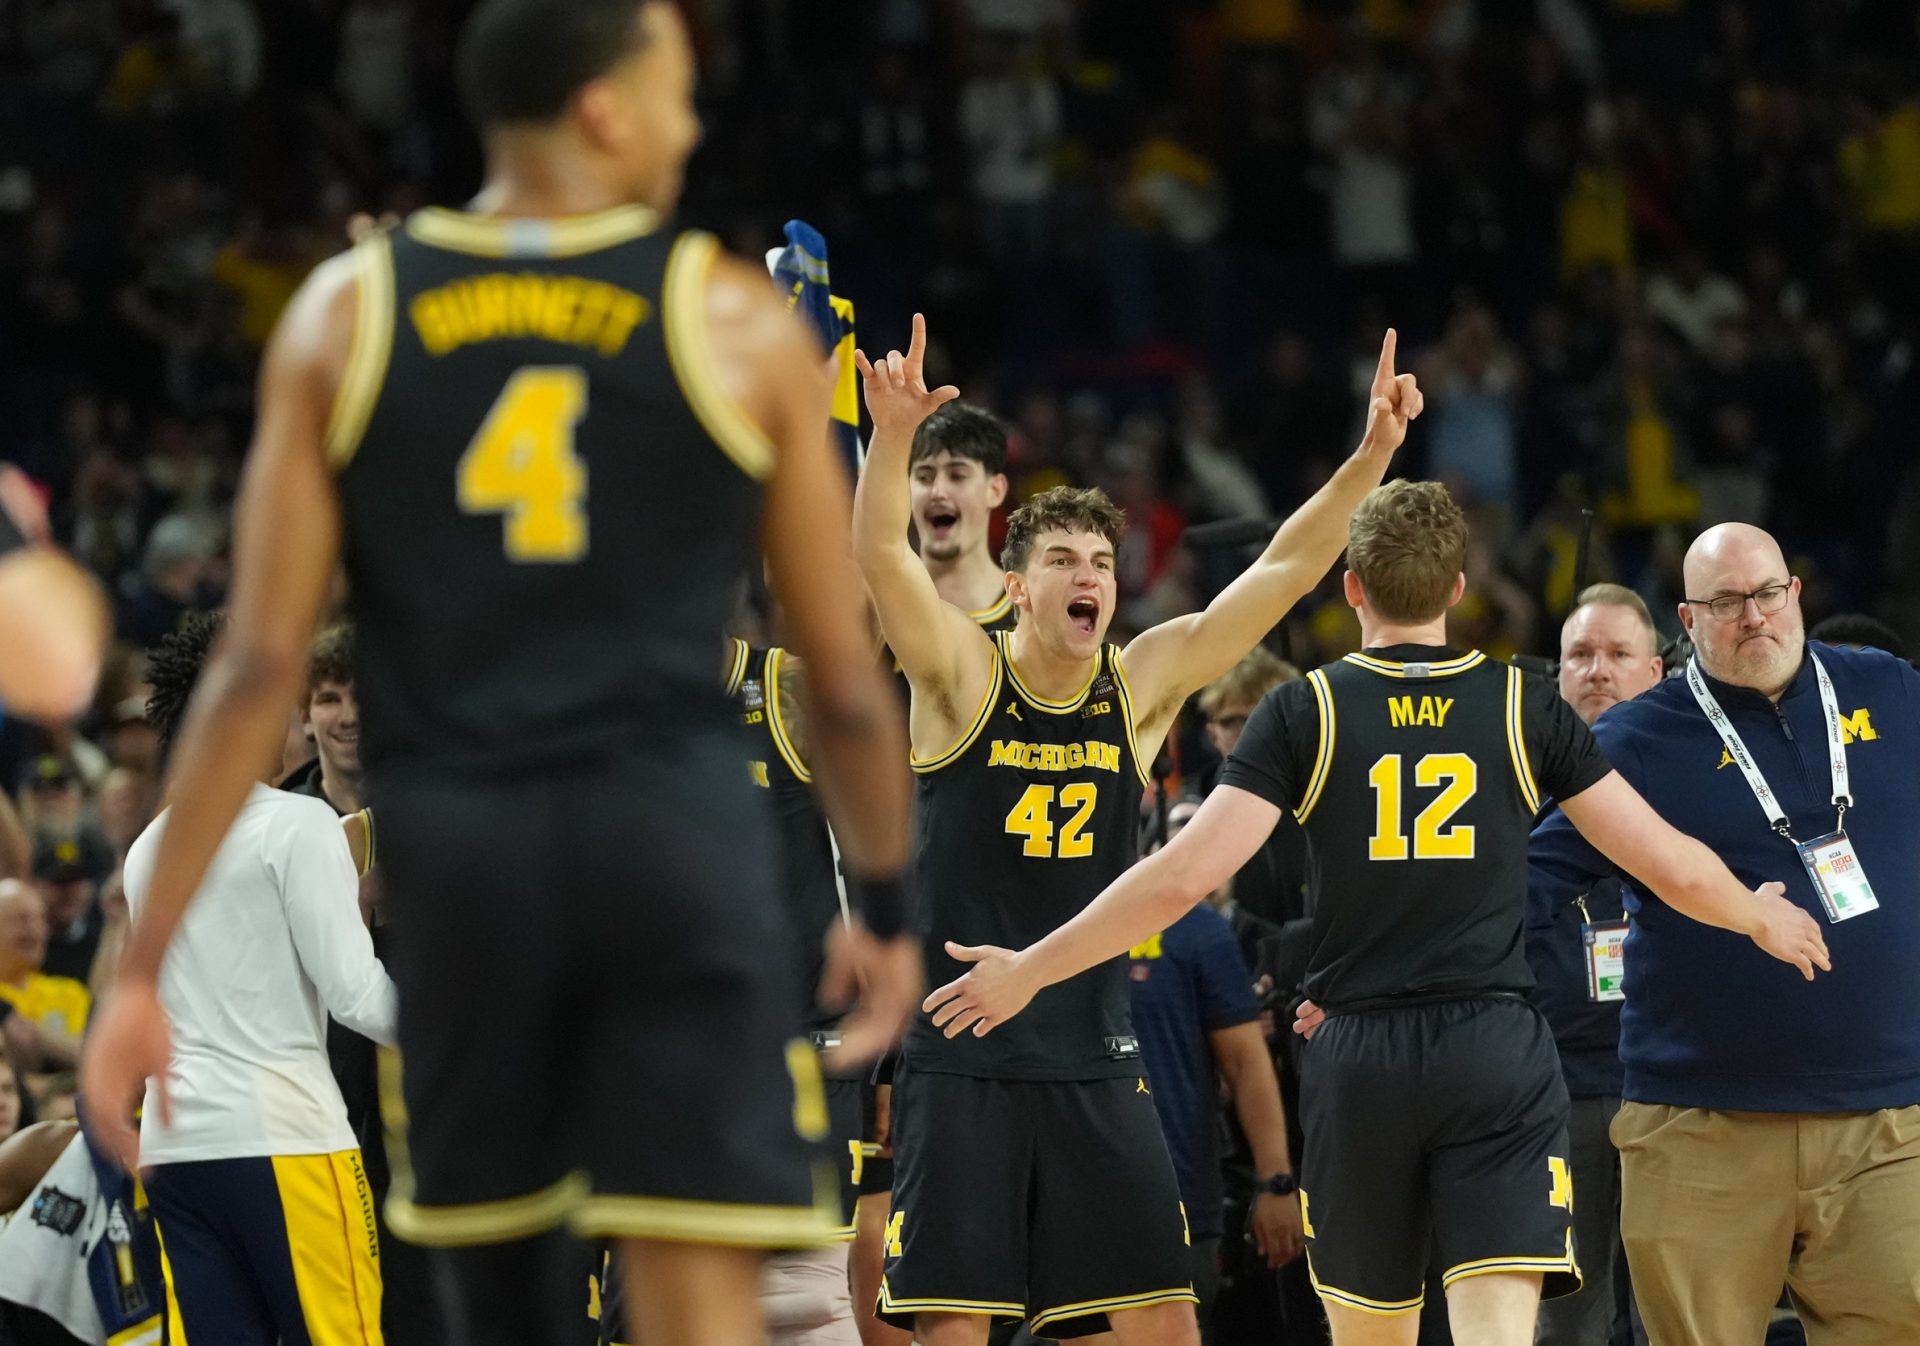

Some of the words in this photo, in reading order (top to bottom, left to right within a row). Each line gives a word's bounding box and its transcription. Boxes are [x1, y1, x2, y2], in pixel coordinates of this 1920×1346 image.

[411, 273, 648, 356] BURNETT
[455, 364, 590, 564] 4
[1388, 696, 1454, 727] MAY
[1839, 708, 1877, 745] M
[988, 739, 1120, 773] MICHIGAN
[1726, 733, 1740, 752] FOUR
[1737, 751, 1751, 770] FINAL
[1005, 782, 1098, 858] 42
[1369, 753, 1477, 860] 12
